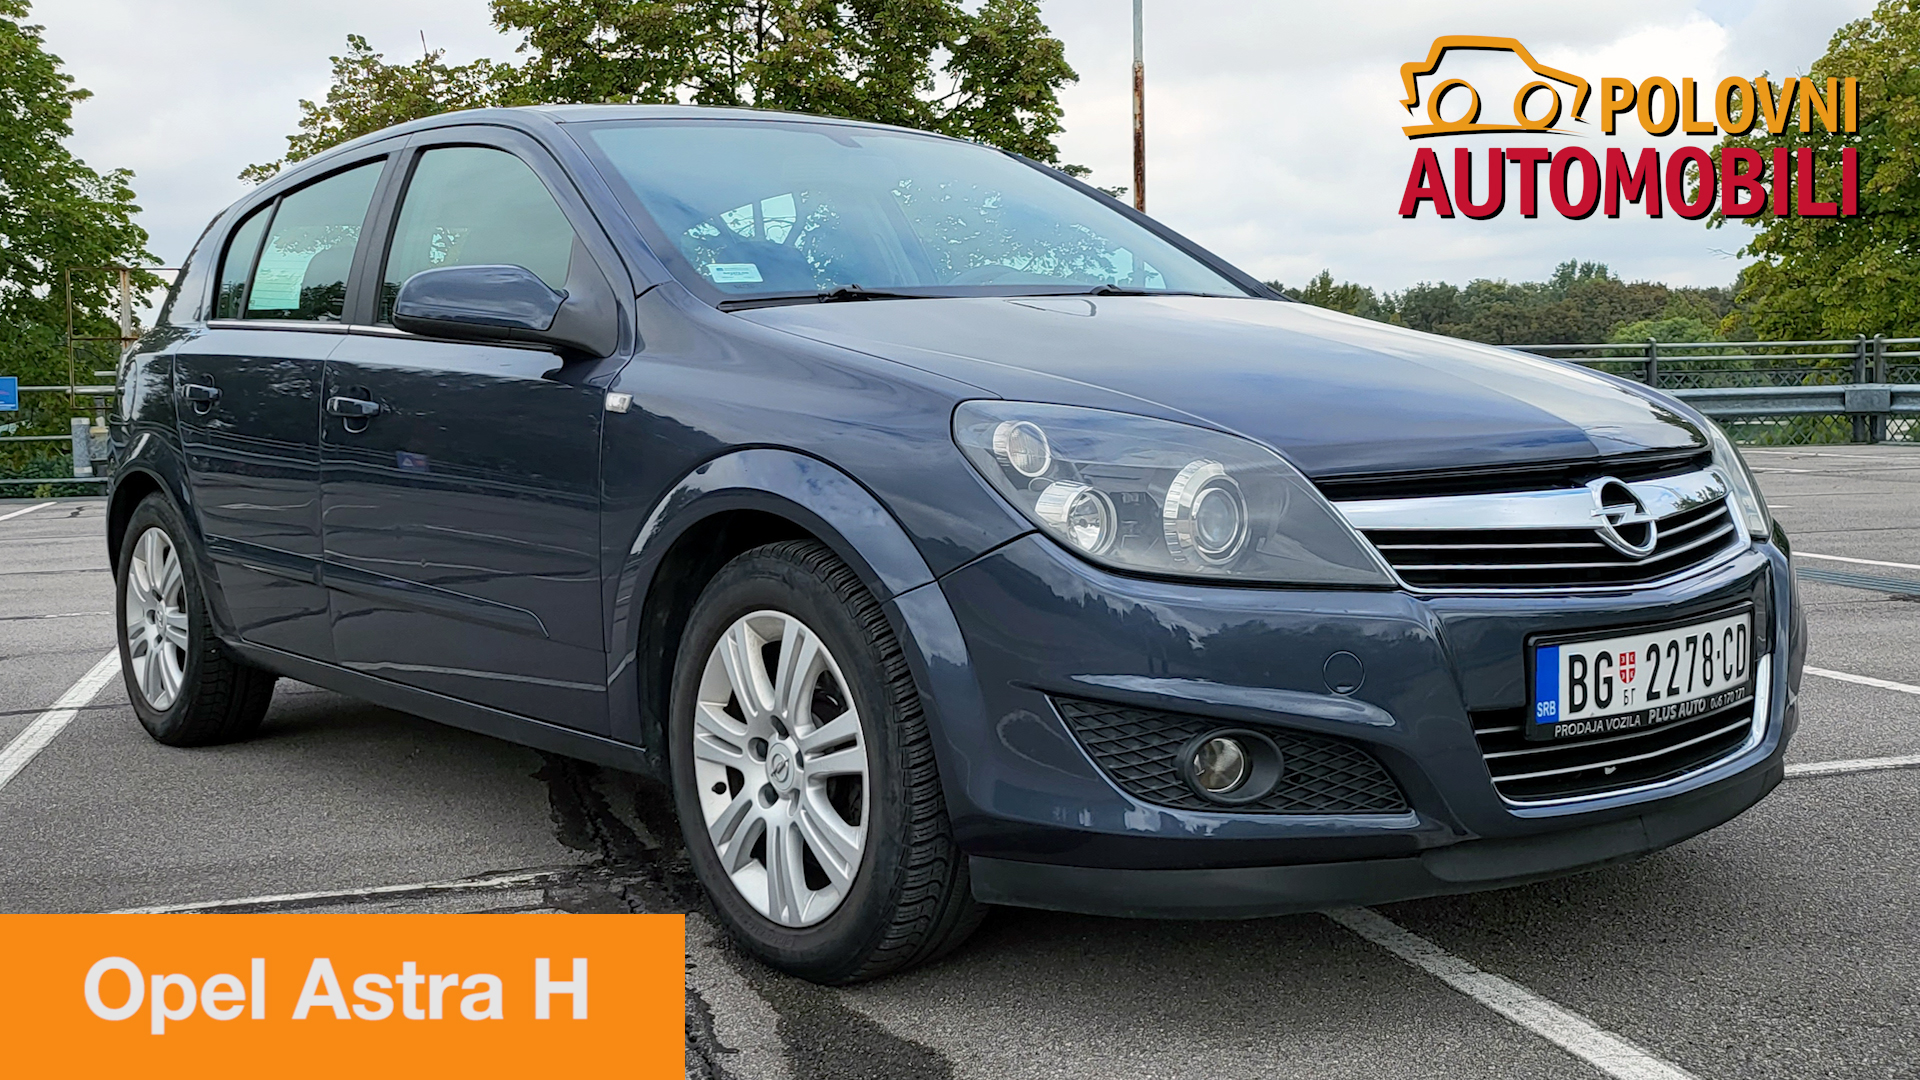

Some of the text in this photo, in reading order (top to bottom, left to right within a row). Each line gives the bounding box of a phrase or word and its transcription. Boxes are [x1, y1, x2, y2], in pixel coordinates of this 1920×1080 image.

[1568, 651, 1613, 714] BG
[1536, 700, 1557, 718] SRB
[1554, 719, 1605, 738] PRODAJA
[1606, 714, 1641, 731] VOZILA
[1648, 704, 1677, 724] PLUS
[1678, 698, 1706, 719] AUTO
